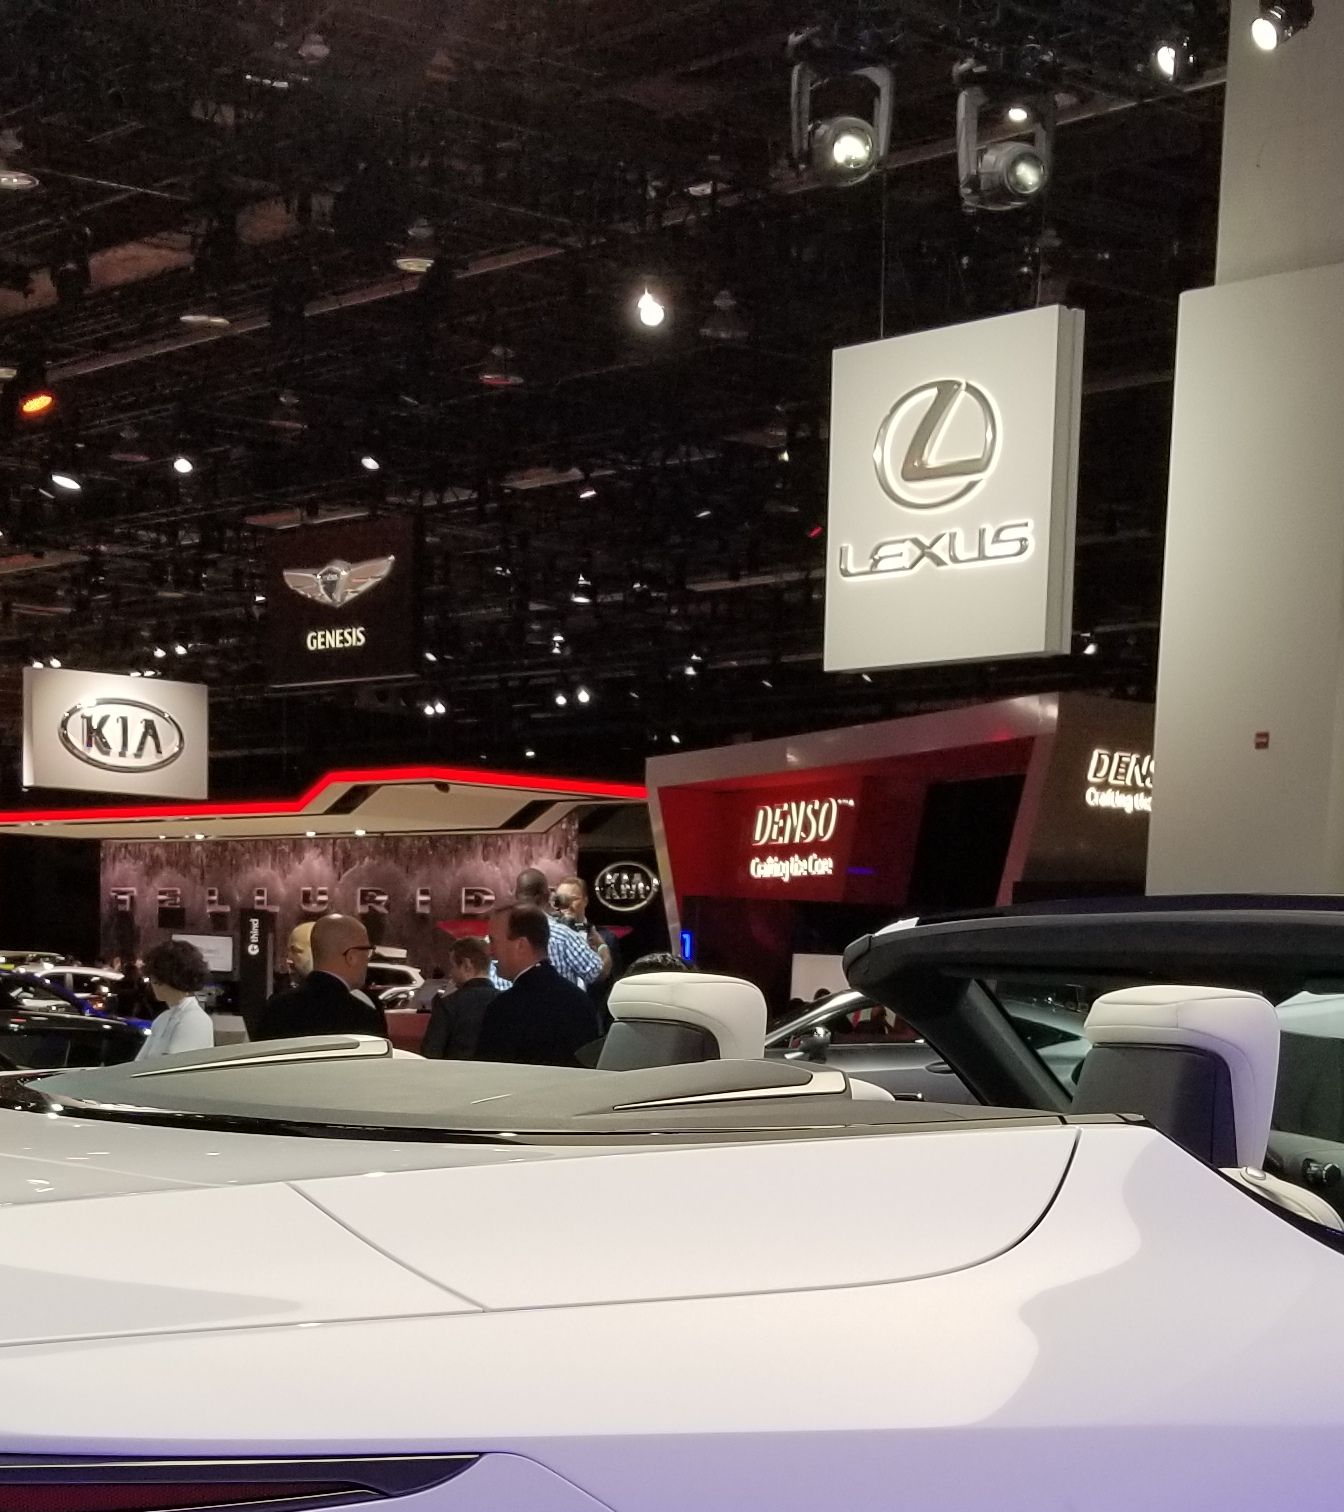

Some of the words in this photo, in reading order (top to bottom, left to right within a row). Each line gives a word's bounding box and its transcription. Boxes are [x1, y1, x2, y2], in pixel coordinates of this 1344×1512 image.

[839, 521, 1030, 578] LEXUS
[307, 626, 365, 650] GENESIS
[81, 714, 163, 758] KIA
[753, 798, 837, 846] DENSO
